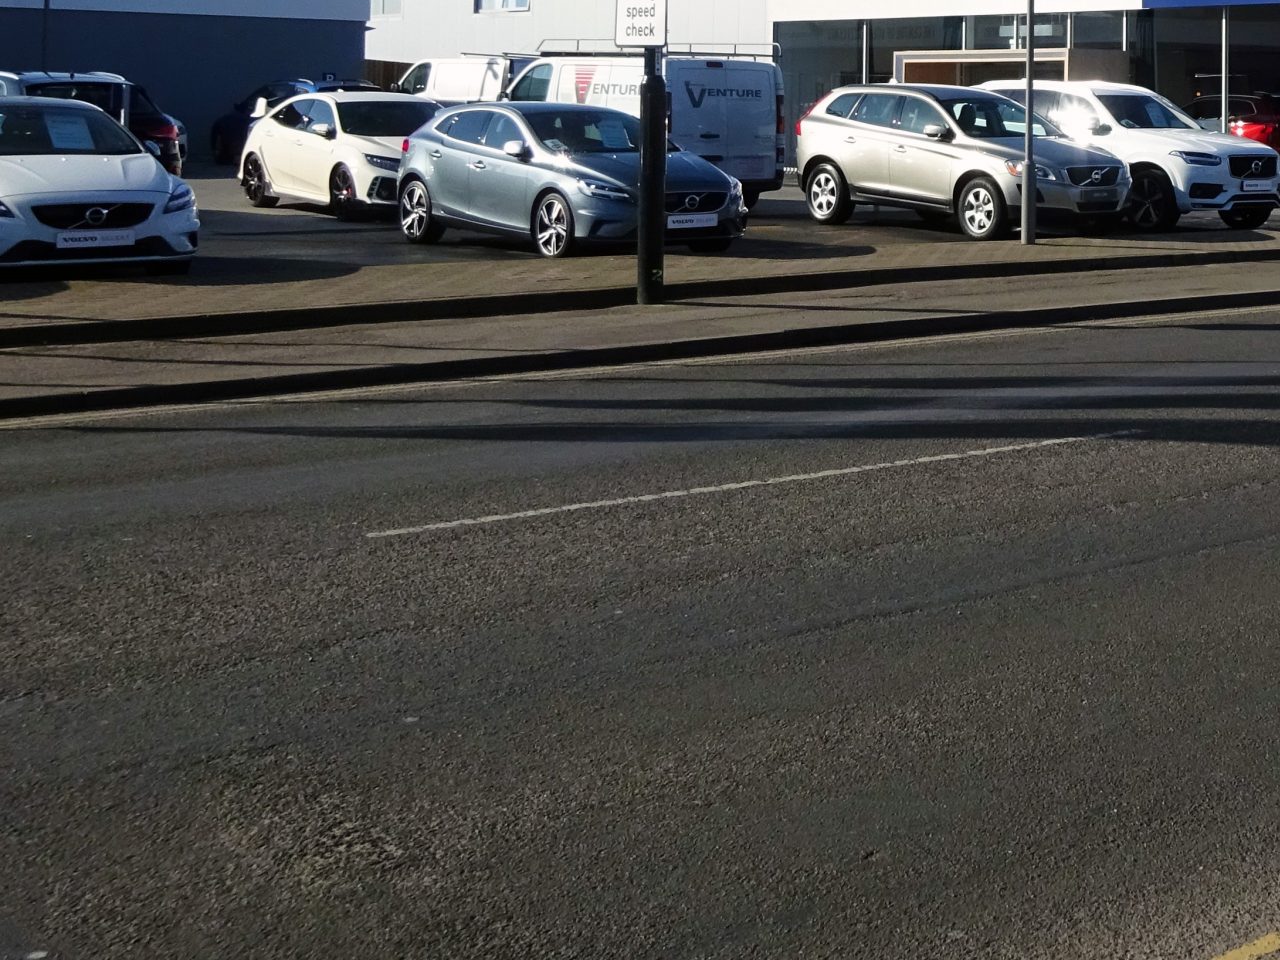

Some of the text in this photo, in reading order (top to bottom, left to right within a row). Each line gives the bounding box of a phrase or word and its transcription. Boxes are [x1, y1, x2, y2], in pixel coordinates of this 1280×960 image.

[626, 3, 656, 18] speed
[625, 22, 656, 37] check
[684, 80, 762, 109] VENTURE
